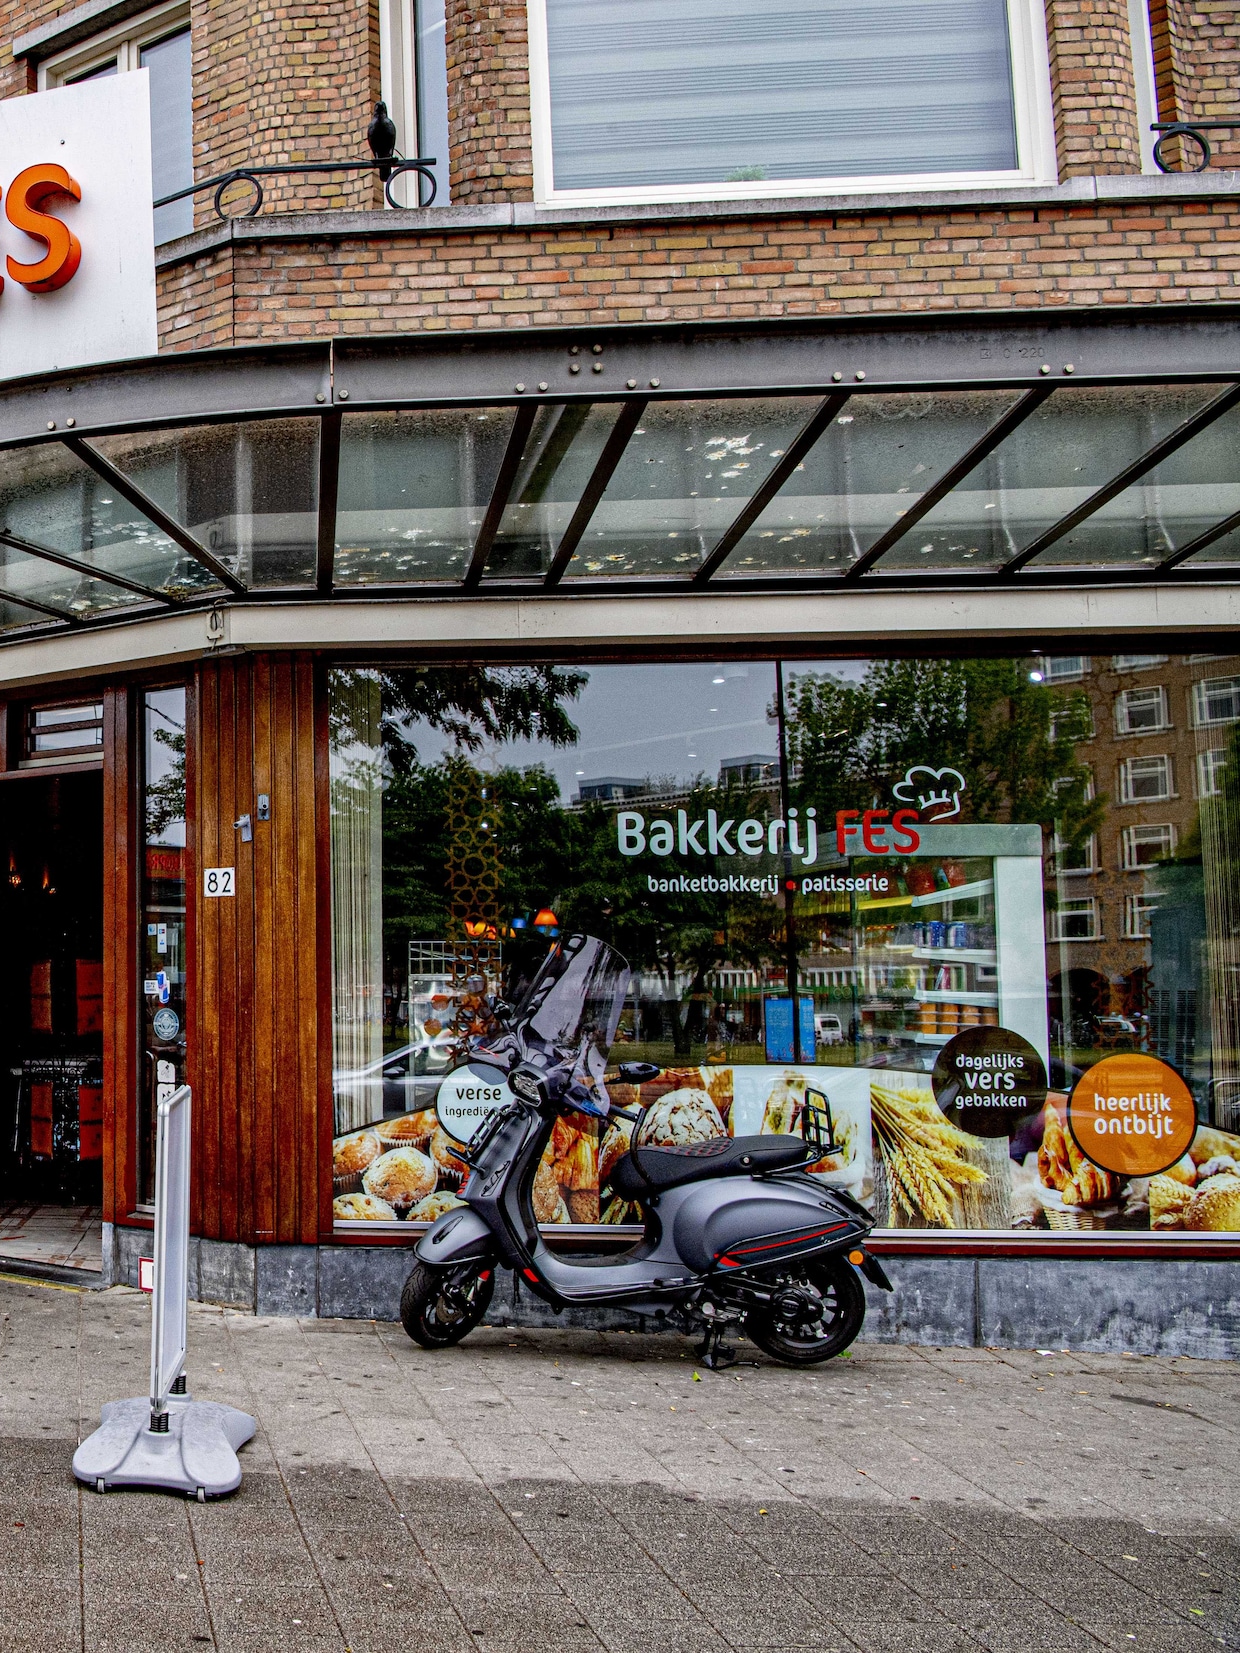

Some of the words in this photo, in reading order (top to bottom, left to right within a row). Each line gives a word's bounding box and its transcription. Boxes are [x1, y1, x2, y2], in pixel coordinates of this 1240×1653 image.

[617, 807, 818, 865] Bakkerij
[835, 808, 921, 855] FES
[207, 871, 231, 893] 82
[647, 874, 780, 895] banketbakkerij
[802, 874, 889, 895] patisserie
[955, 1053, 1025, 1071] dagelijks
[964, 1072, 1016, 1090] vers
[455, 1087, 502, 1100] verse
[955, 1093, 1027, 1109] gebakken
[1094, 1092, 1172, 1115] heerlijk
[1093, 1116, 1174, 1140] ontbijt
